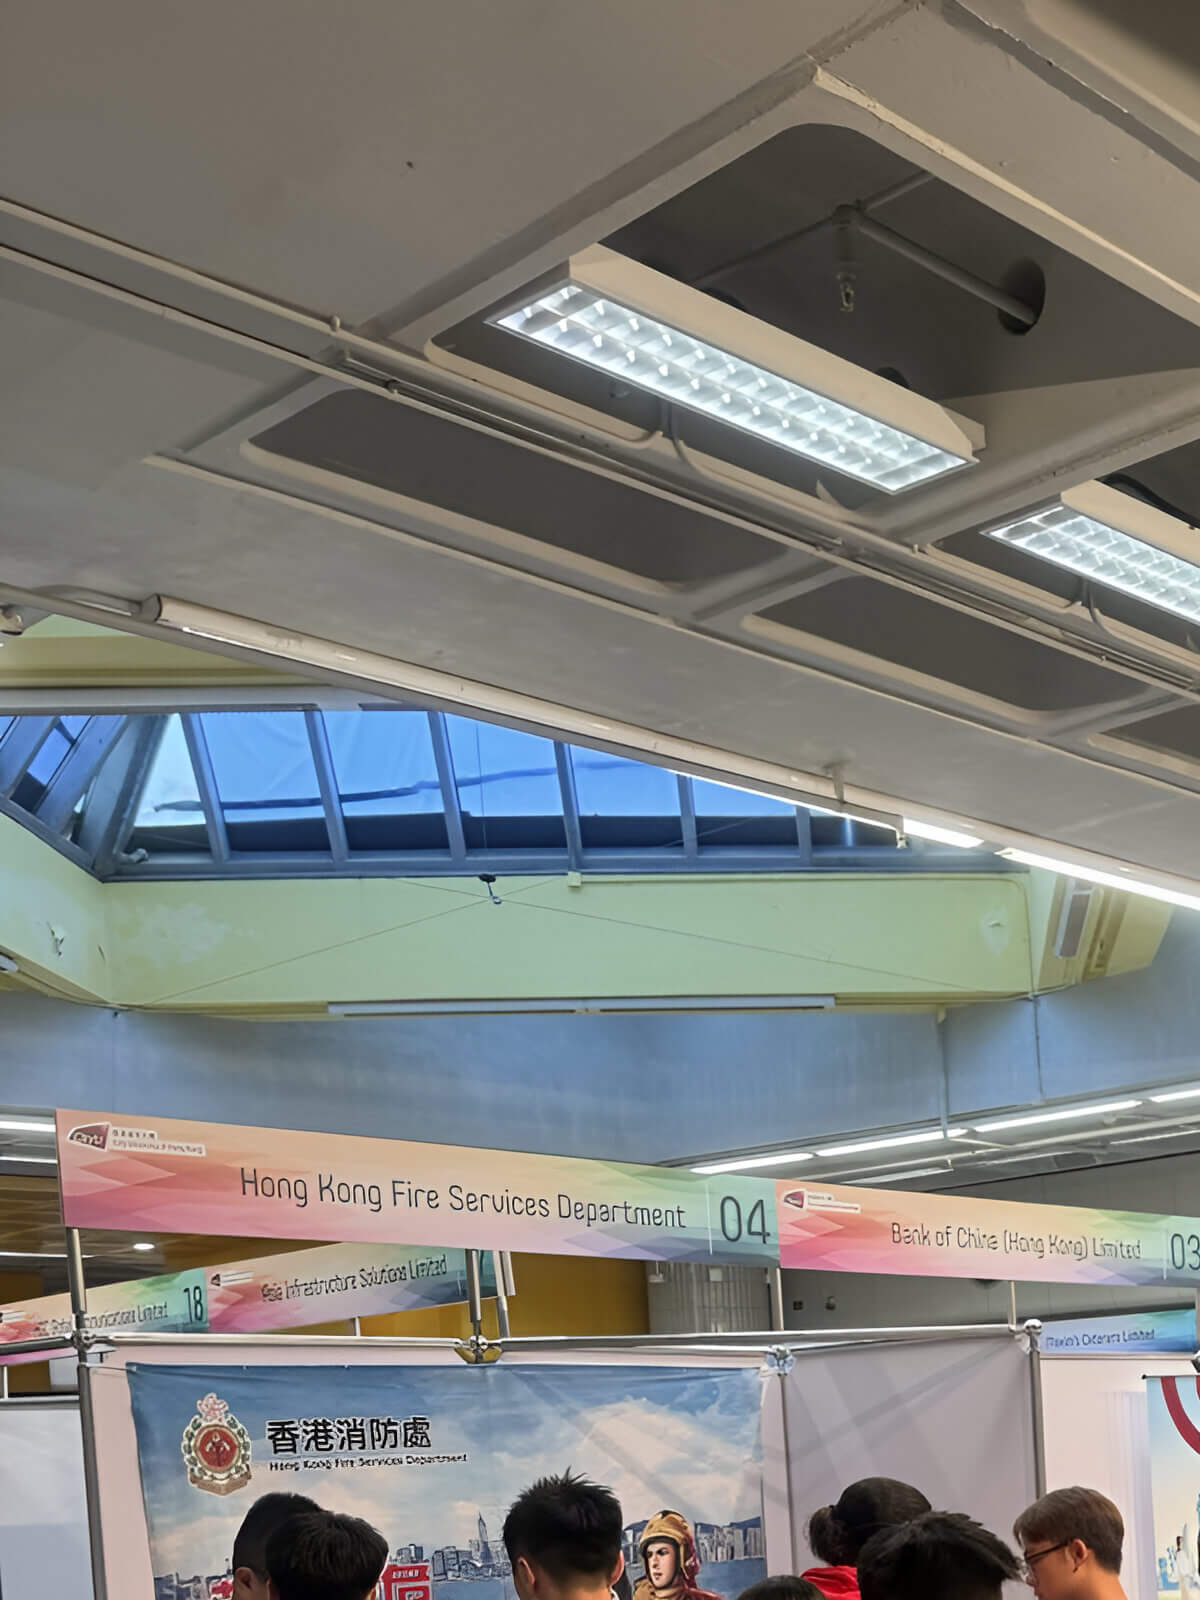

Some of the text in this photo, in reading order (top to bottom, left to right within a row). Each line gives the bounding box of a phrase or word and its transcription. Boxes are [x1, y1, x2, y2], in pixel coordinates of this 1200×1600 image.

[240, 1167, 308, 1208] Hong
[318, 1173, 382, 1212] Kong
[392, 1180, 440, 1209] Fire
[450, 1185, 550, 1218] Services
[558, 1194, 687, 1228] Department
[720, 1195, 771, 1244] 04
[892, 1223, 931, 1247] Bank
[936, 1225, 952, 1246] of
[957, 1227, 999, 1250] China
[1004, 1230, 1045, 1259] (Hong
[1049, 1234, 1089, 1261] Kong)
[1093, 1237, 1142, 1260] Limited
[409, 1254, 448, 1280] Limited
[184, 1285, 205, 1323] 18
[267, 1416, 431, 1454] 香港消防處
